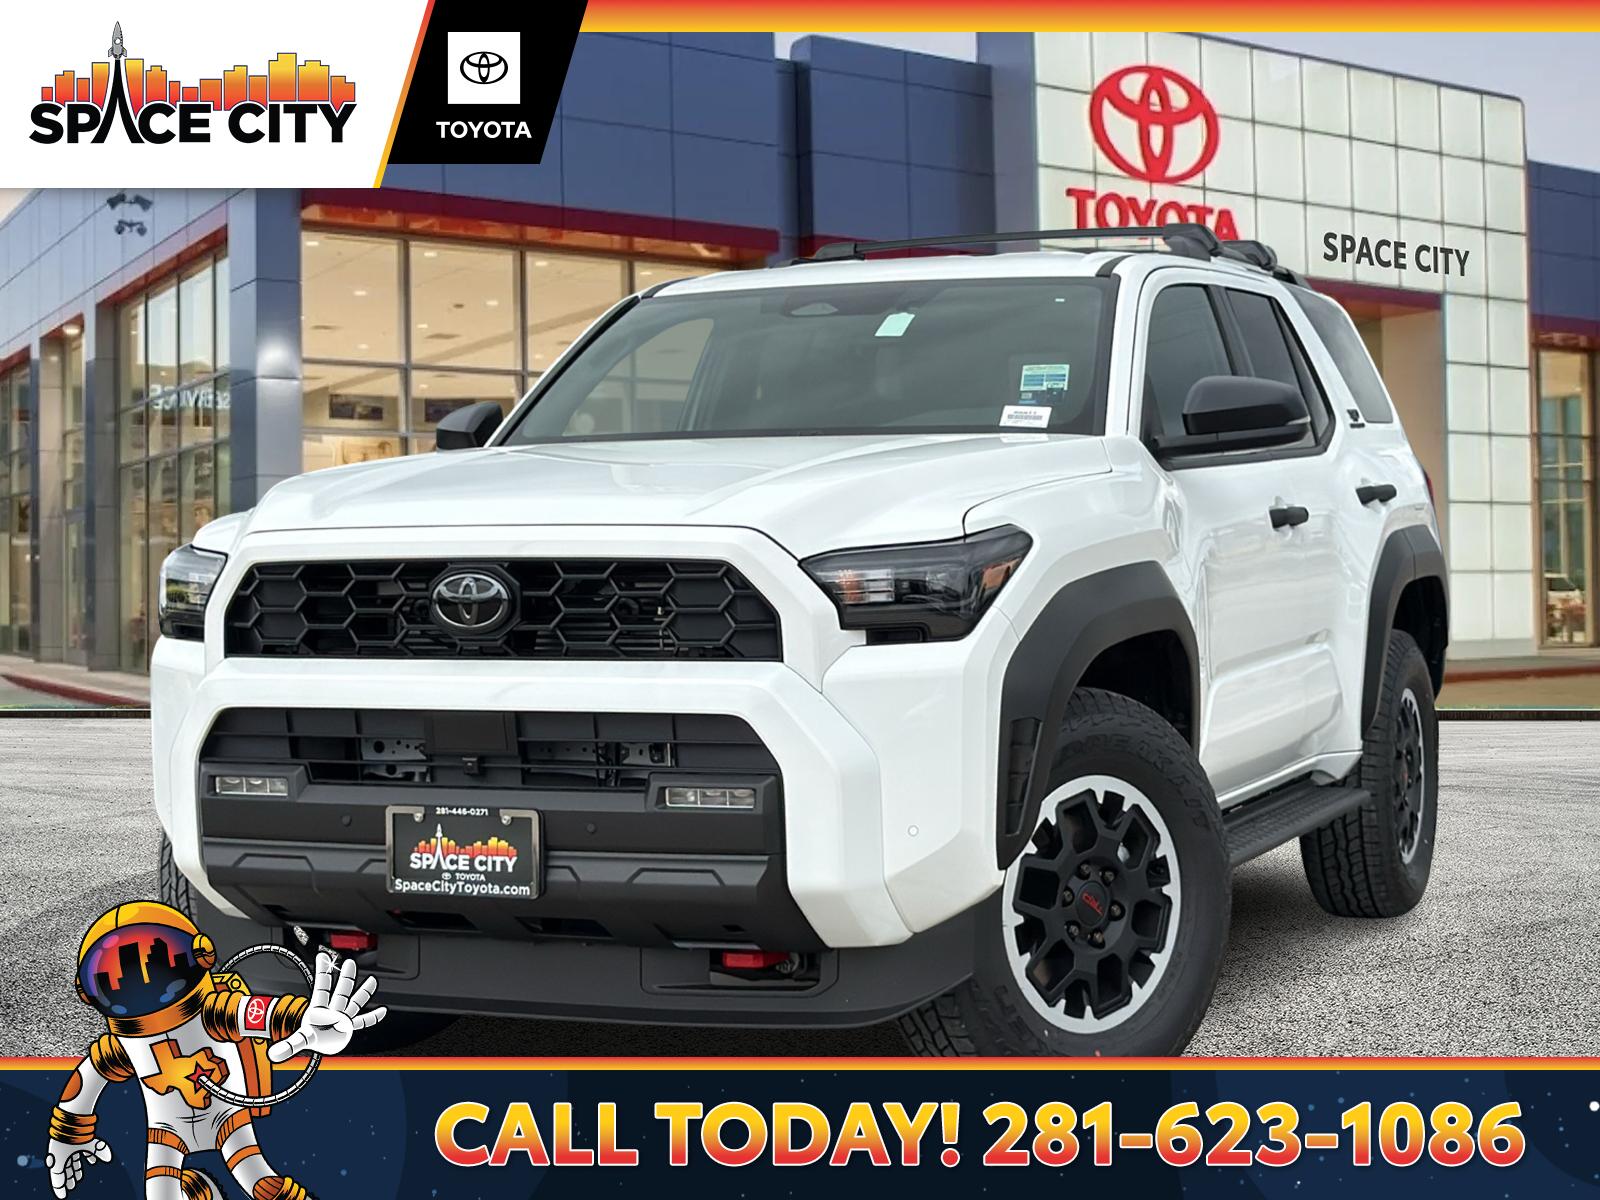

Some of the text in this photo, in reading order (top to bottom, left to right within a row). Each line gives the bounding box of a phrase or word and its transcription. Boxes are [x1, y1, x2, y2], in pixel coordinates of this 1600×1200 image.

[1322, 231, 1470, 277] SPACE CITY
[409, 846, 518, 873] SPACE CITY
[394, 879, 531, 896] SpaceCityToyota.com
[455, 872, 486, 882] TOYOTA
